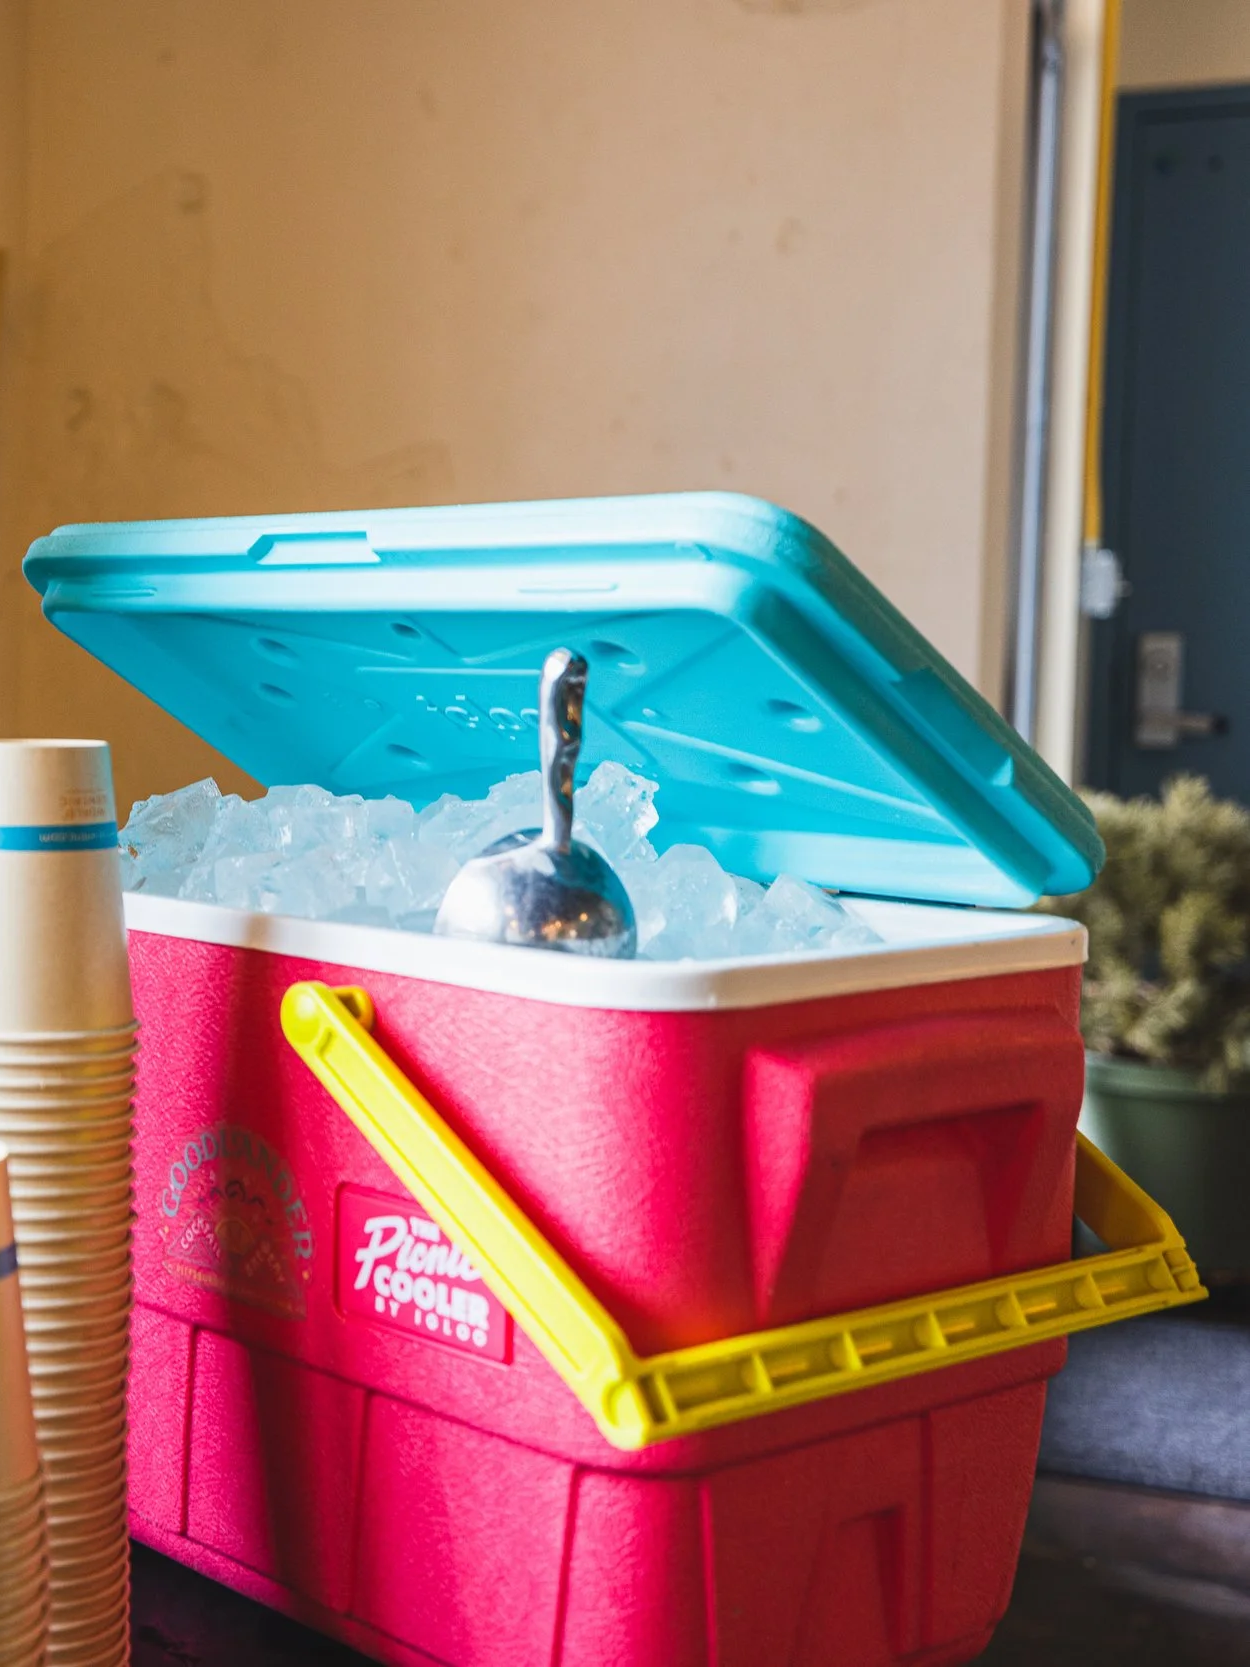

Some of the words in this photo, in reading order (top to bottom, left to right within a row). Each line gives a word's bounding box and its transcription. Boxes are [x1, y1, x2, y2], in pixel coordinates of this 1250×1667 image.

[373, 1264, 490, 1331] COOLER
[374, 1295, 400, 1318] BY
[413, 1307, 488, 1348] IGLOO
